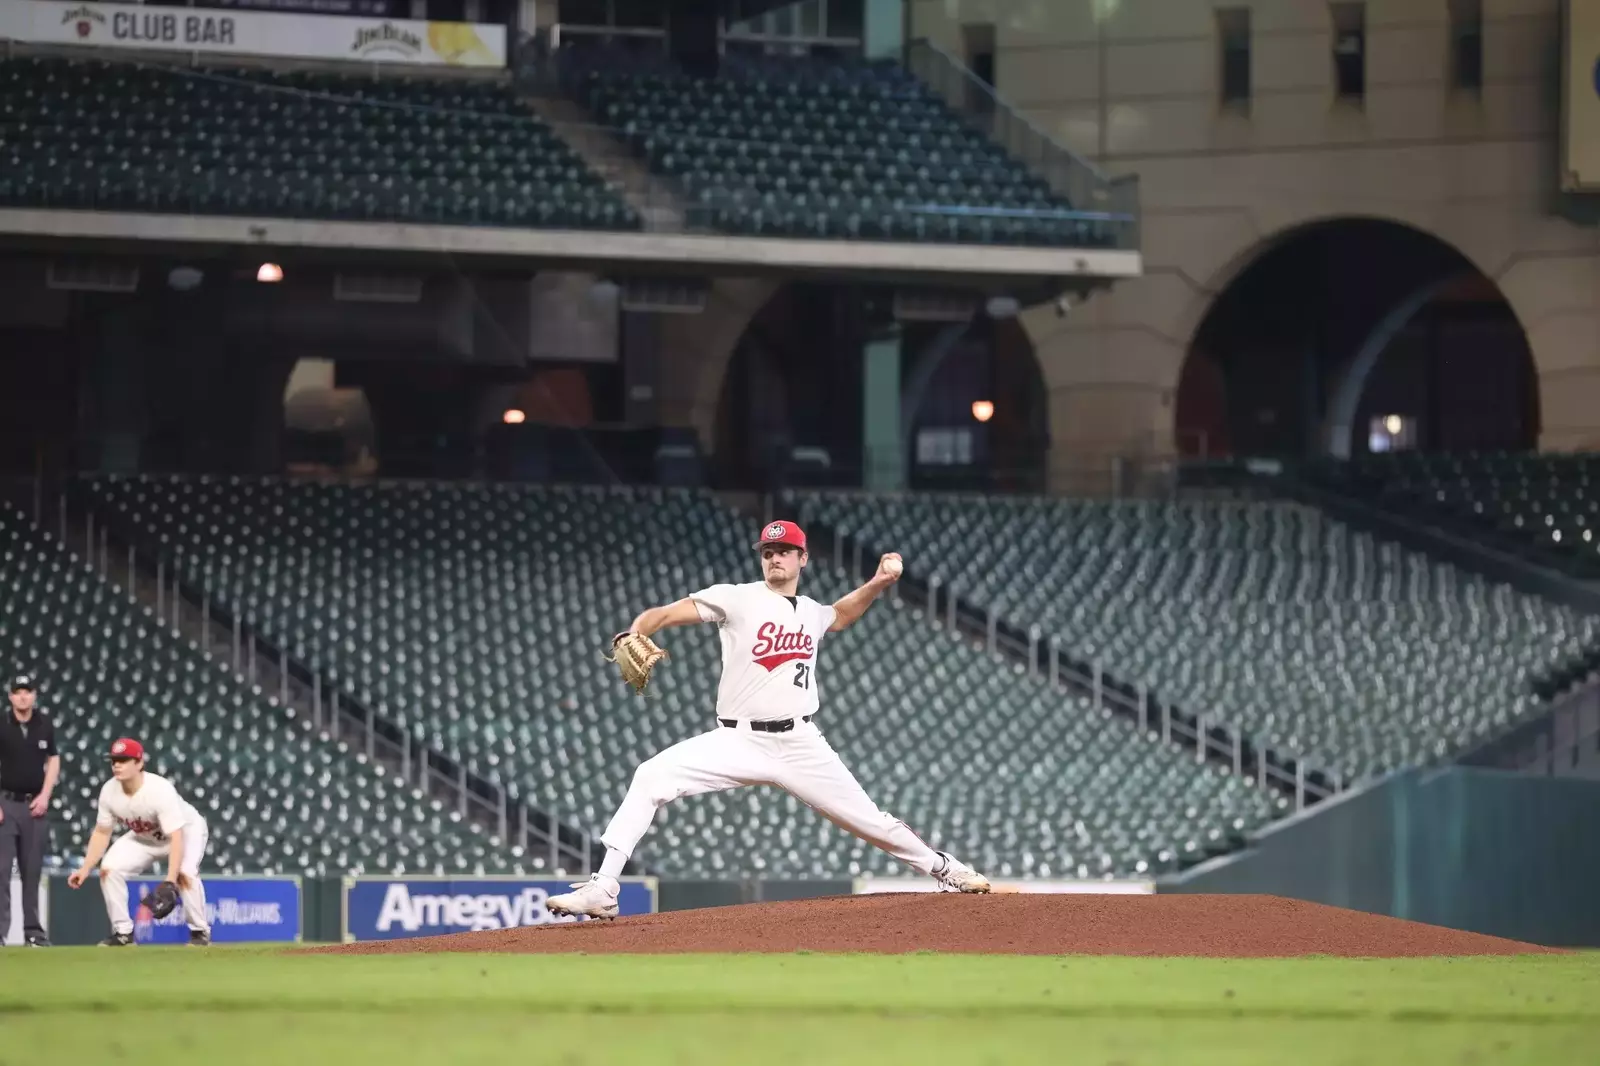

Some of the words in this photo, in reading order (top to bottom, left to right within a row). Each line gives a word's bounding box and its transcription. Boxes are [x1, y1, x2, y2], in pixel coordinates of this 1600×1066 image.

[112, 11, 177, 42] CLUB
[184, 16, 237, 45] BAR
[752, 621, 814, 657] State
[793, 662, 810, 690] 21
[375, 883, 592, 932] AmegyB
